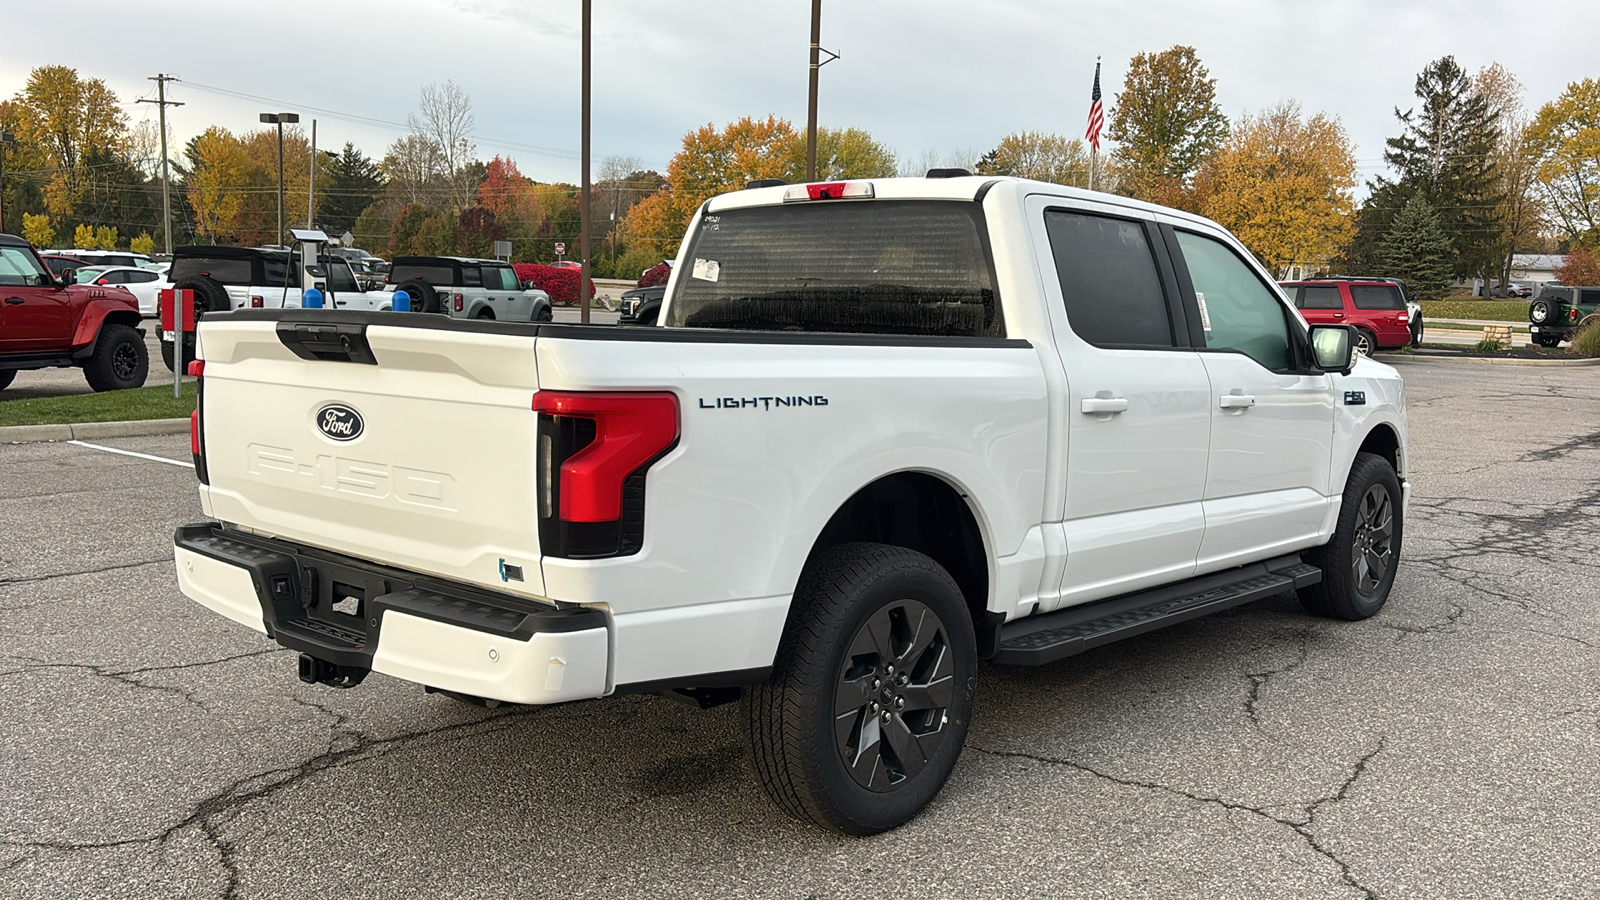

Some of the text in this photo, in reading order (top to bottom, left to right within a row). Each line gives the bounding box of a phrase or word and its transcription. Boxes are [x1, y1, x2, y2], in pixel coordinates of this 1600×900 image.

[699, 396, 829, 412] LIGHTNING
[322, 409, 355, 436] Ford
[247, 442, 459, 512] F-150
